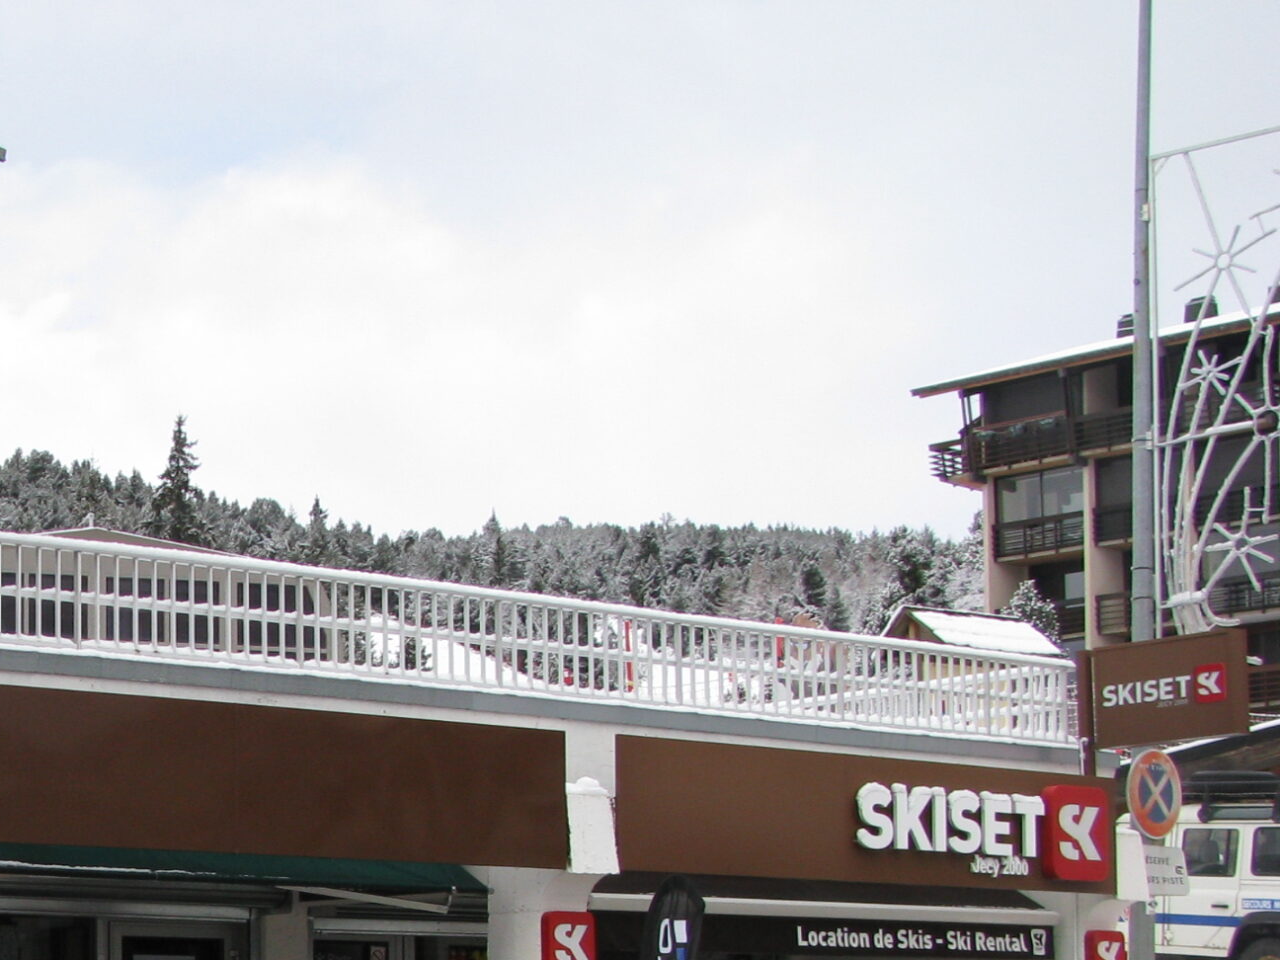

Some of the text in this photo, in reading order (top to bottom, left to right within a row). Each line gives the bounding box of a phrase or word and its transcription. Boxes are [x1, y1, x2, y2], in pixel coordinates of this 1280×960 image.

[1102, 674, 1192, 708] SKISET
[855, 782, 1046, 858] SKISET
[970, 855, 1029, 879] Jecy 2000
[797, 925, 870, 948] Location
[873, 928, 893, 949] de
[897, 929, 933, 950] Skis
[947, 930, 971, 951] Ski
[975, 931, 1028, 953] Rental
